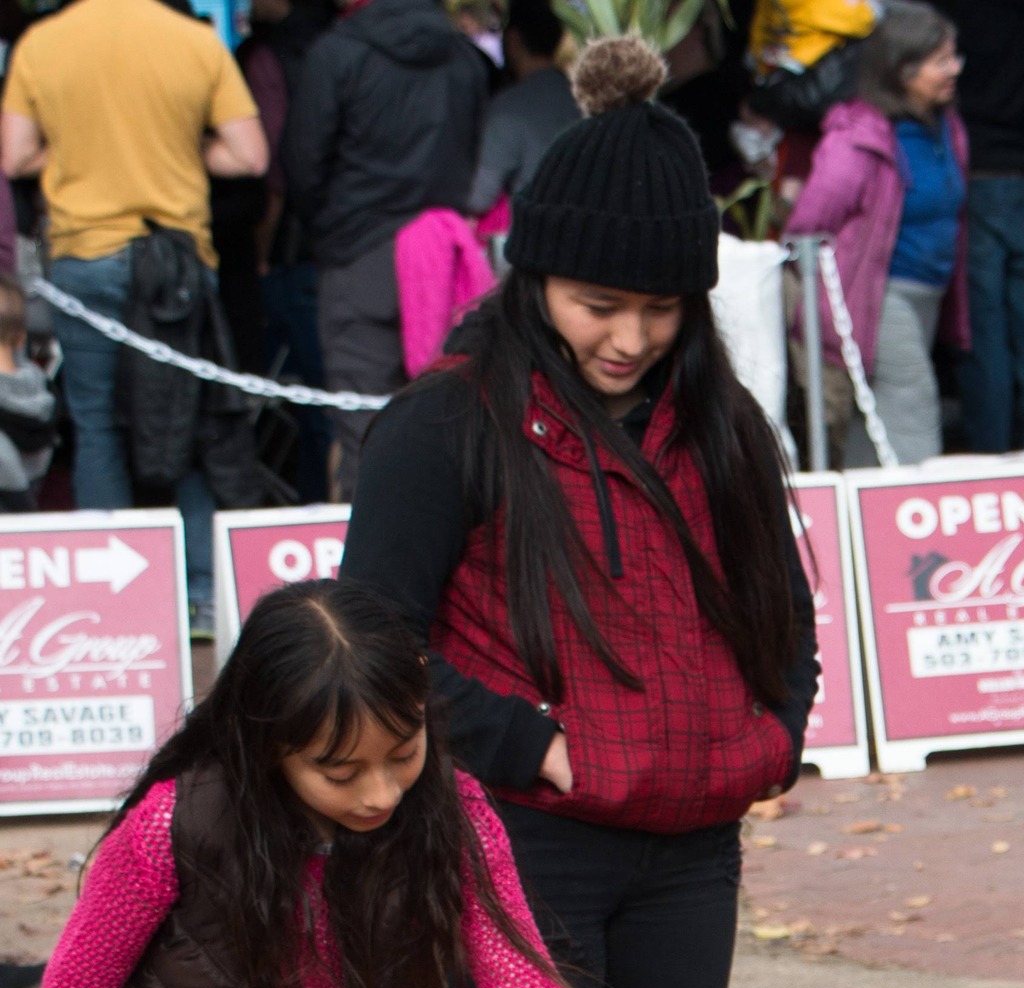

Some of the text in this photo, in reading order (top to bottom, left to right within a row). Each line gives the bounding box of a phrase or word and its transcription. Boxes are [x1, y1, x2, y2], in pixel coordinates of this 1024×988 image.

[0, 546, 71, 590] EN
[268, 537, 345, 582] OP
[929, 533, 1024, 603] A
[913, 605, 990, 626] REAL
[29, 610, 162, 681] Group
[938, 629, 996, 648] AMY
[22, 672, 152, 694] ESTATE
[23, 703, 131, 726] SAVAGE
